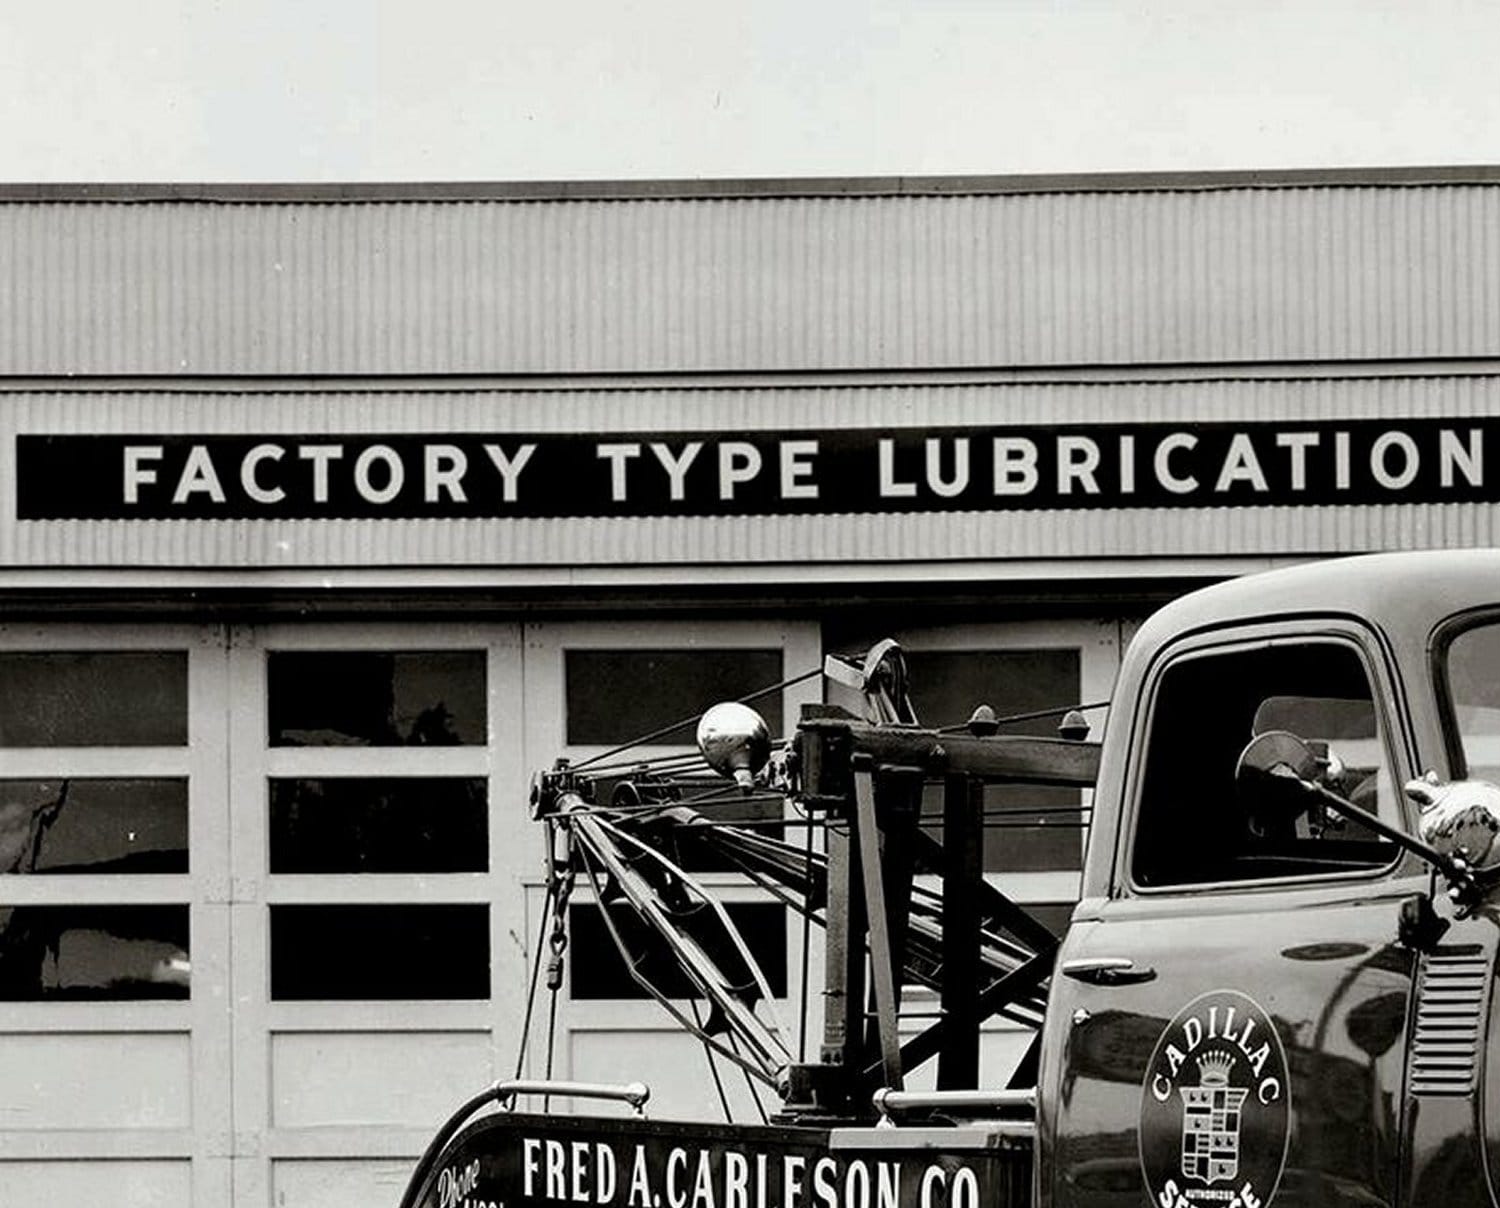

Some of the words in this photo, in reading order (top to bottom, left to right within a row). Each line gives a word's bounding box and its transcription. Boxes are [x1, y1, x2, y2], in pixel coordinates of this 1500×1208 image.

[122, 443, 538, 504] FACTORY
[596, 438, 820, 501] TYPE
[878, 428, 1486, 498] LUBRICATION
[1151, 1006, 1281, 1105] CADILLAC
[523, 1138, 618, 1204] FRED
